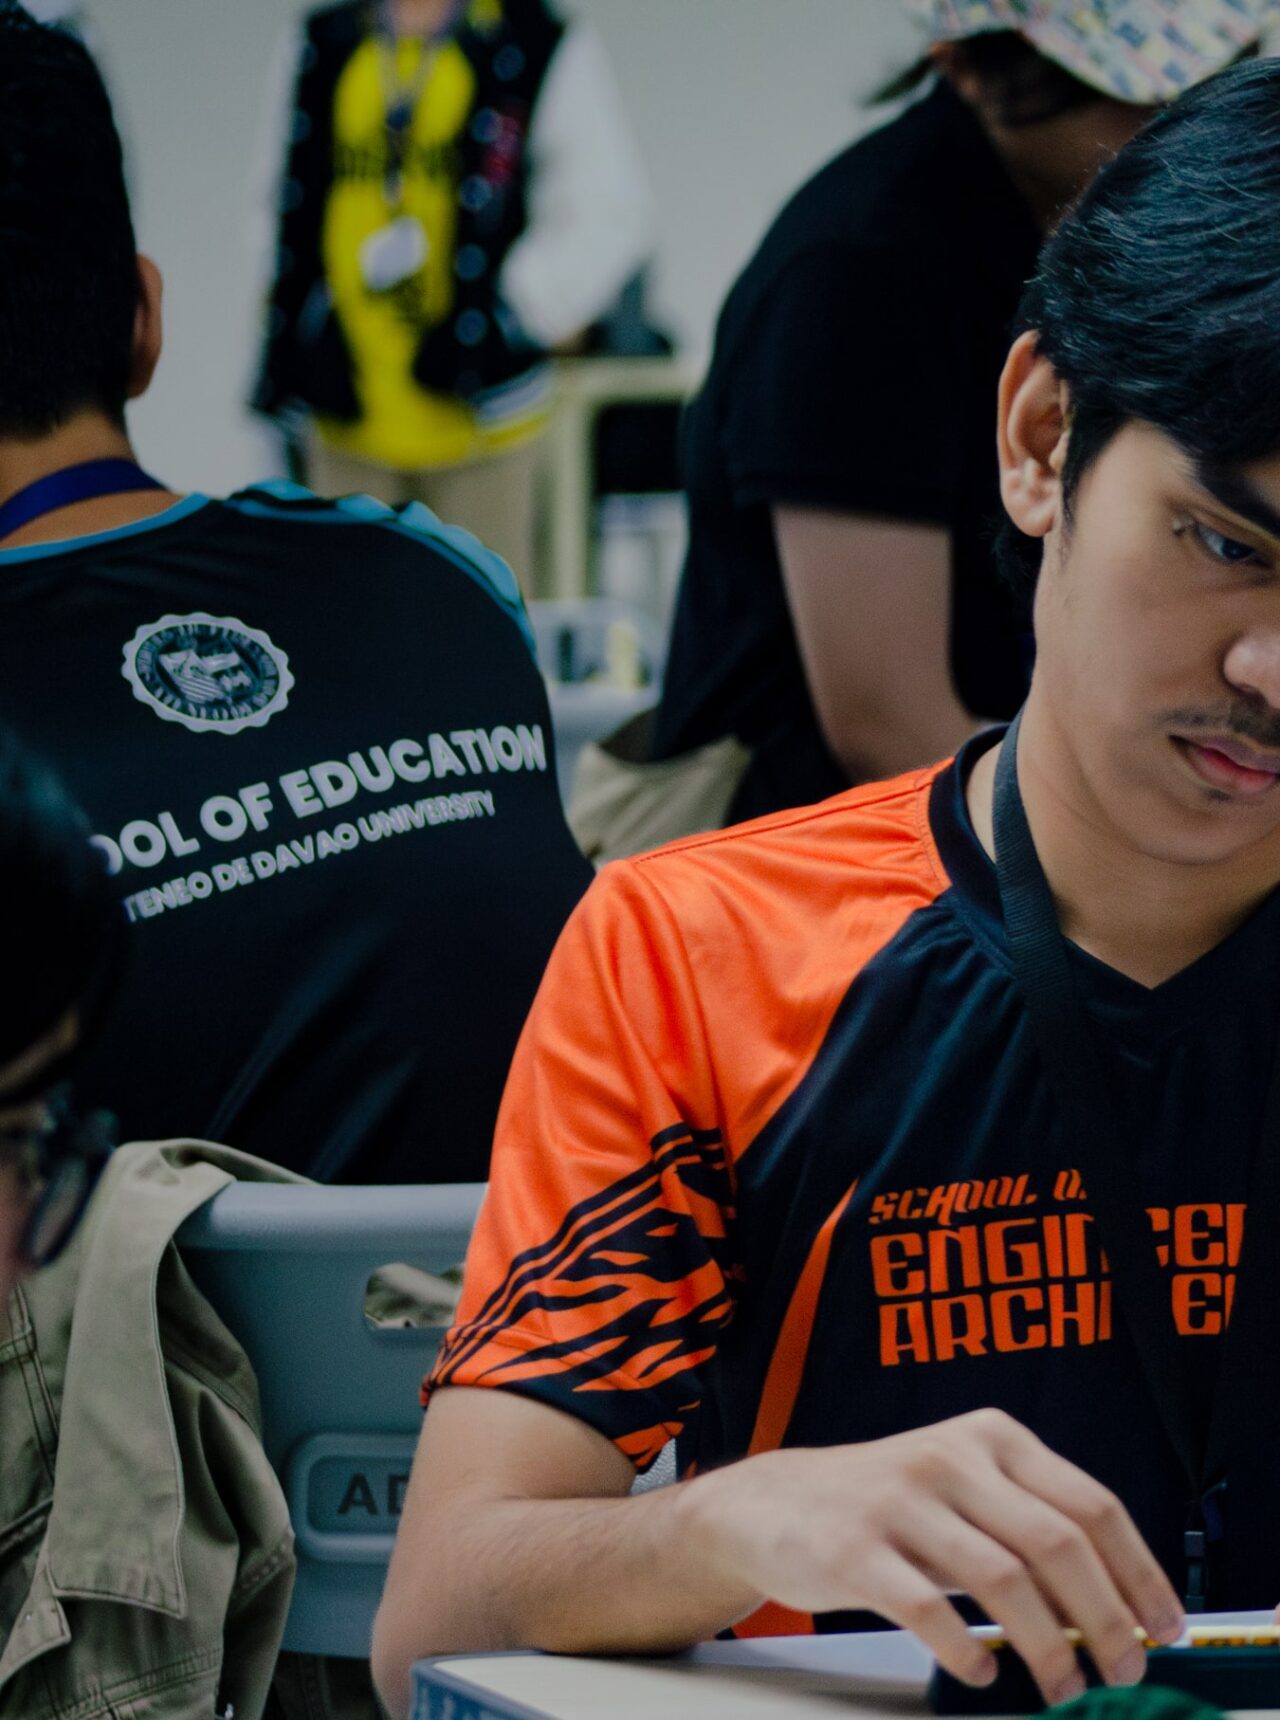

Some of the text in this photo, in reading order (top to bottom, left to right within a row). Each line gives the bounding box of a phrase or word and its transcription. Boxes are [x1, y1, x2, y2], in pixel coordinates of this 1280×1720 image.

[199, 781, 275, 843] OF
[278, 723, 548, 820] EDUCATION
[211, 856, 255, 892] DE
[250, 821, 360, 880] DAVAO
[357, 789, 497, 843] UNIVERSITY
[868, 1168, 1088, 1227] SCHOOL O
